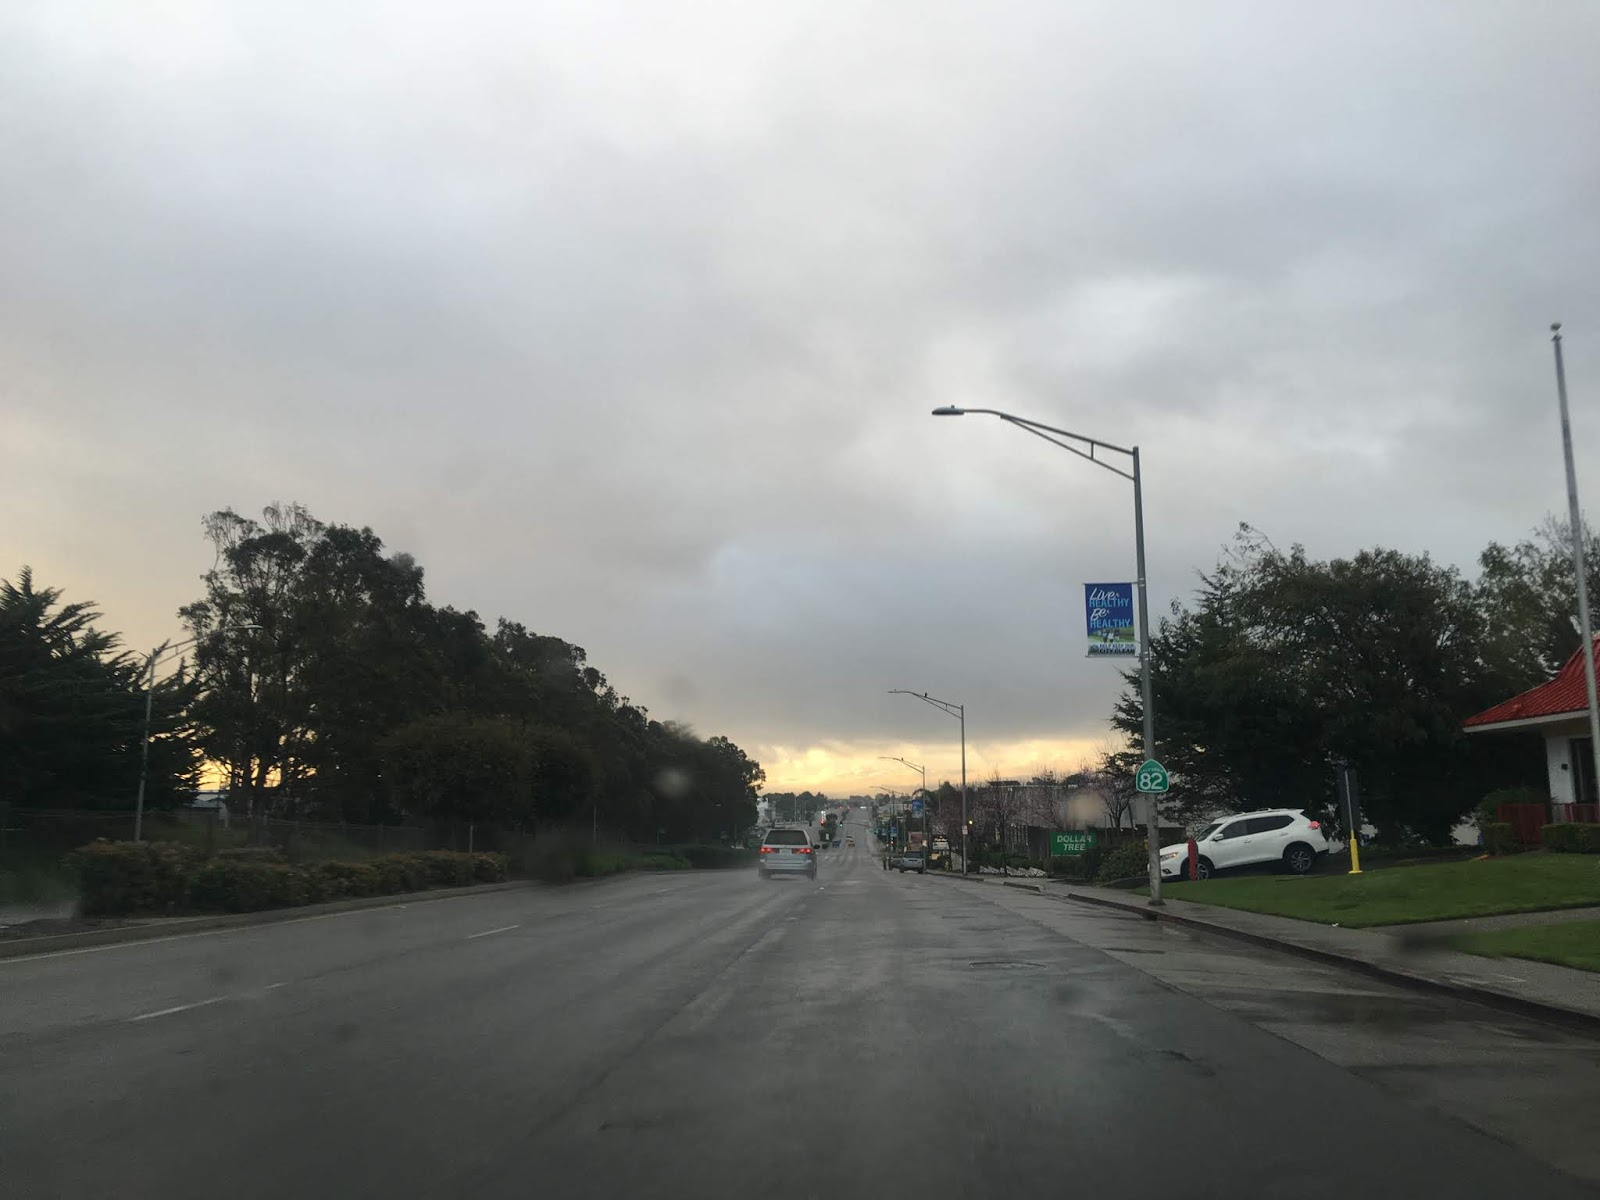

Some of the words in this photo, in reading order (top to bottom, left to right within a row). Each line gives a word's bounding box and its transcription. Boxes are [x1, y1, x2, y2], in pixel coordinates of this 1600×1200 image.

[1089, 587, 1120, 601] Live
[1089, 598, 1129, 608] HEALTHY
[1090, 618, 1131, 629] HEALTHY
[1139, 772, 1163, 790] 82
[1056, 835, 1092, 843] DOLLAR
[1063, 843, 1086, 851] TREE
